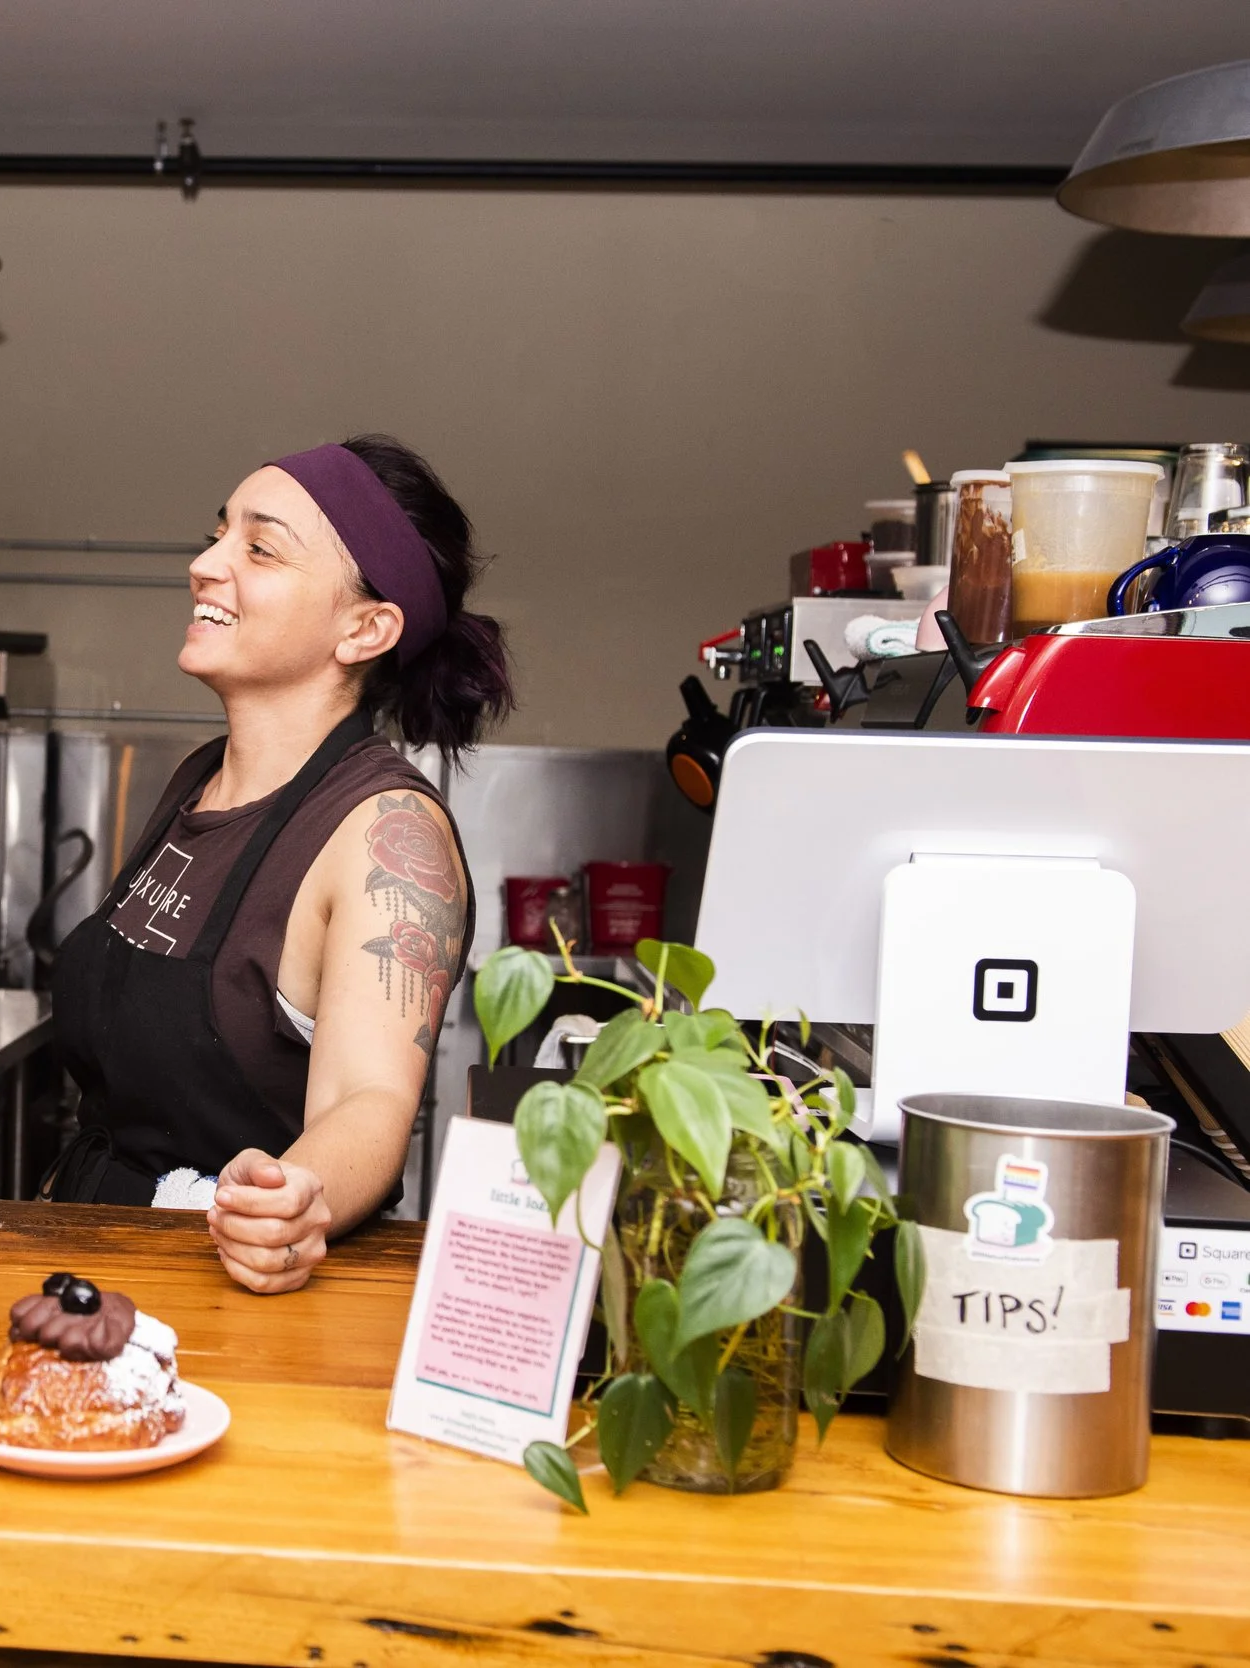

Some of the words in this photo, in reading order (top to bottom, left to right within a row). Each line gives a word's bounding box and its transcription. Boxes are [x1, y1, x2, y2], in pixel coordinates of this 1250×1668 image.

[129, 866, 191, 919] UXURE
[1203, 1245, 1250, 1261] Square
[952, 1285, 1065, 1334] TIPS!
